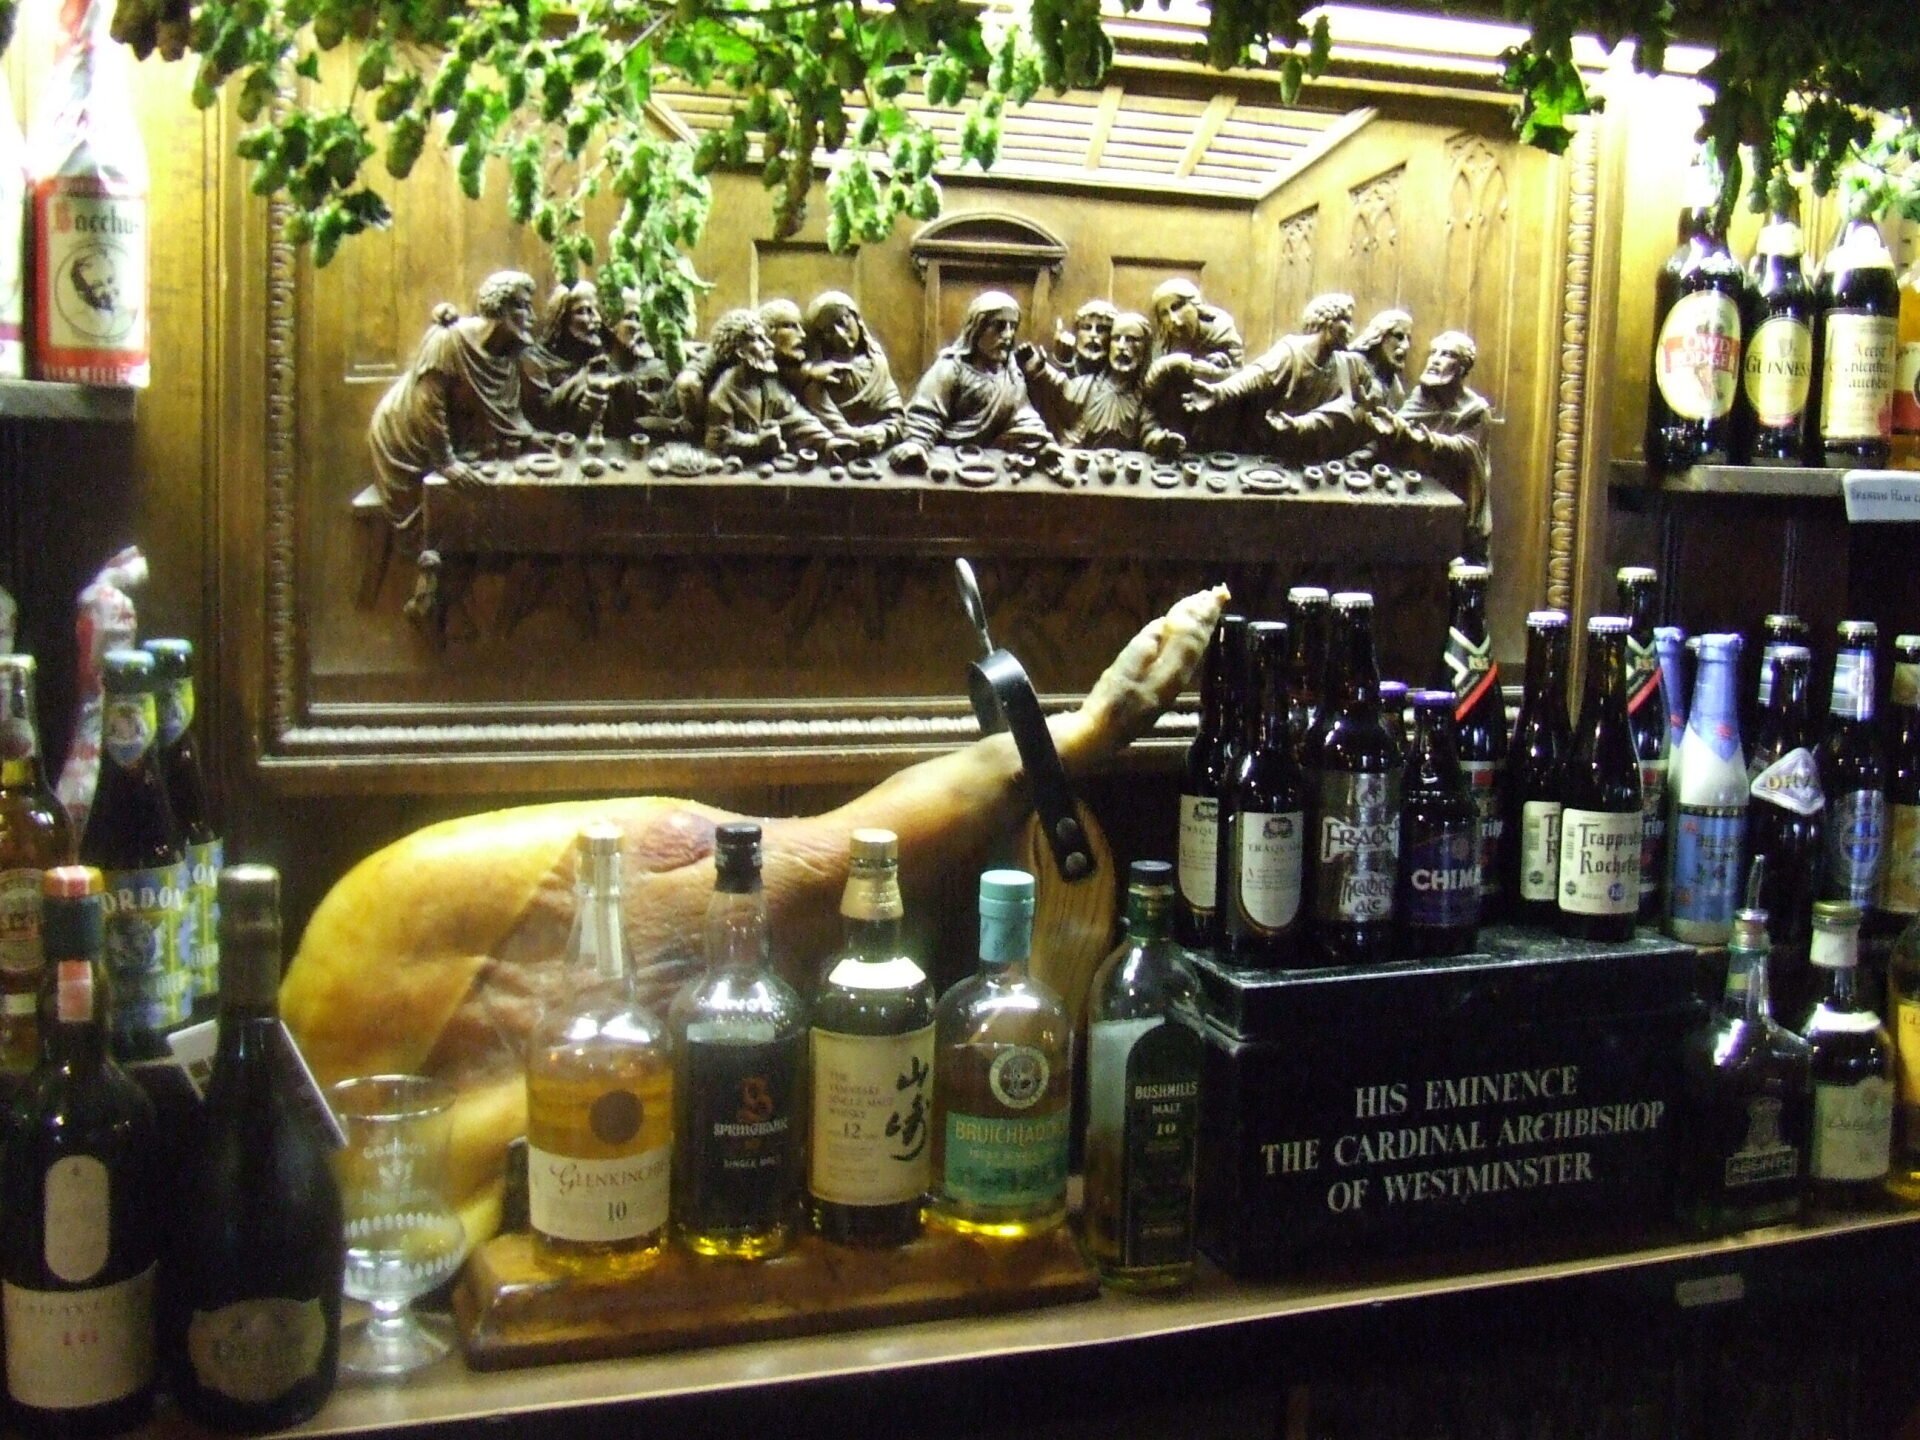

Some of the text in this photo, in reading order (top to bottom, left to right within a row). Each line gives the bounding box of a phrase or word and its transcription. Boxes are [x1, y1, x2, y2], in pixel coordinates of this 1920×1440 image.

[101, 886, 185, 913] ORDON
[1134, 1081, 1199, 1100] BUSHMILLS
[1354, 1065, 1580, 1119] HIS EMINENCE
[1152, 1102, 1181, 1115] MALT
[843, 1121, 861, 1140] 12
[1156, 1122, 1177, 1136] 10
[1260, 1100, 1666, 1176] THE CARDINAL ARCHBISHOP
[1326, 1151, 1595, 1214] OF WESTMINSTER
[608, 1200, 627, 1221] 10
